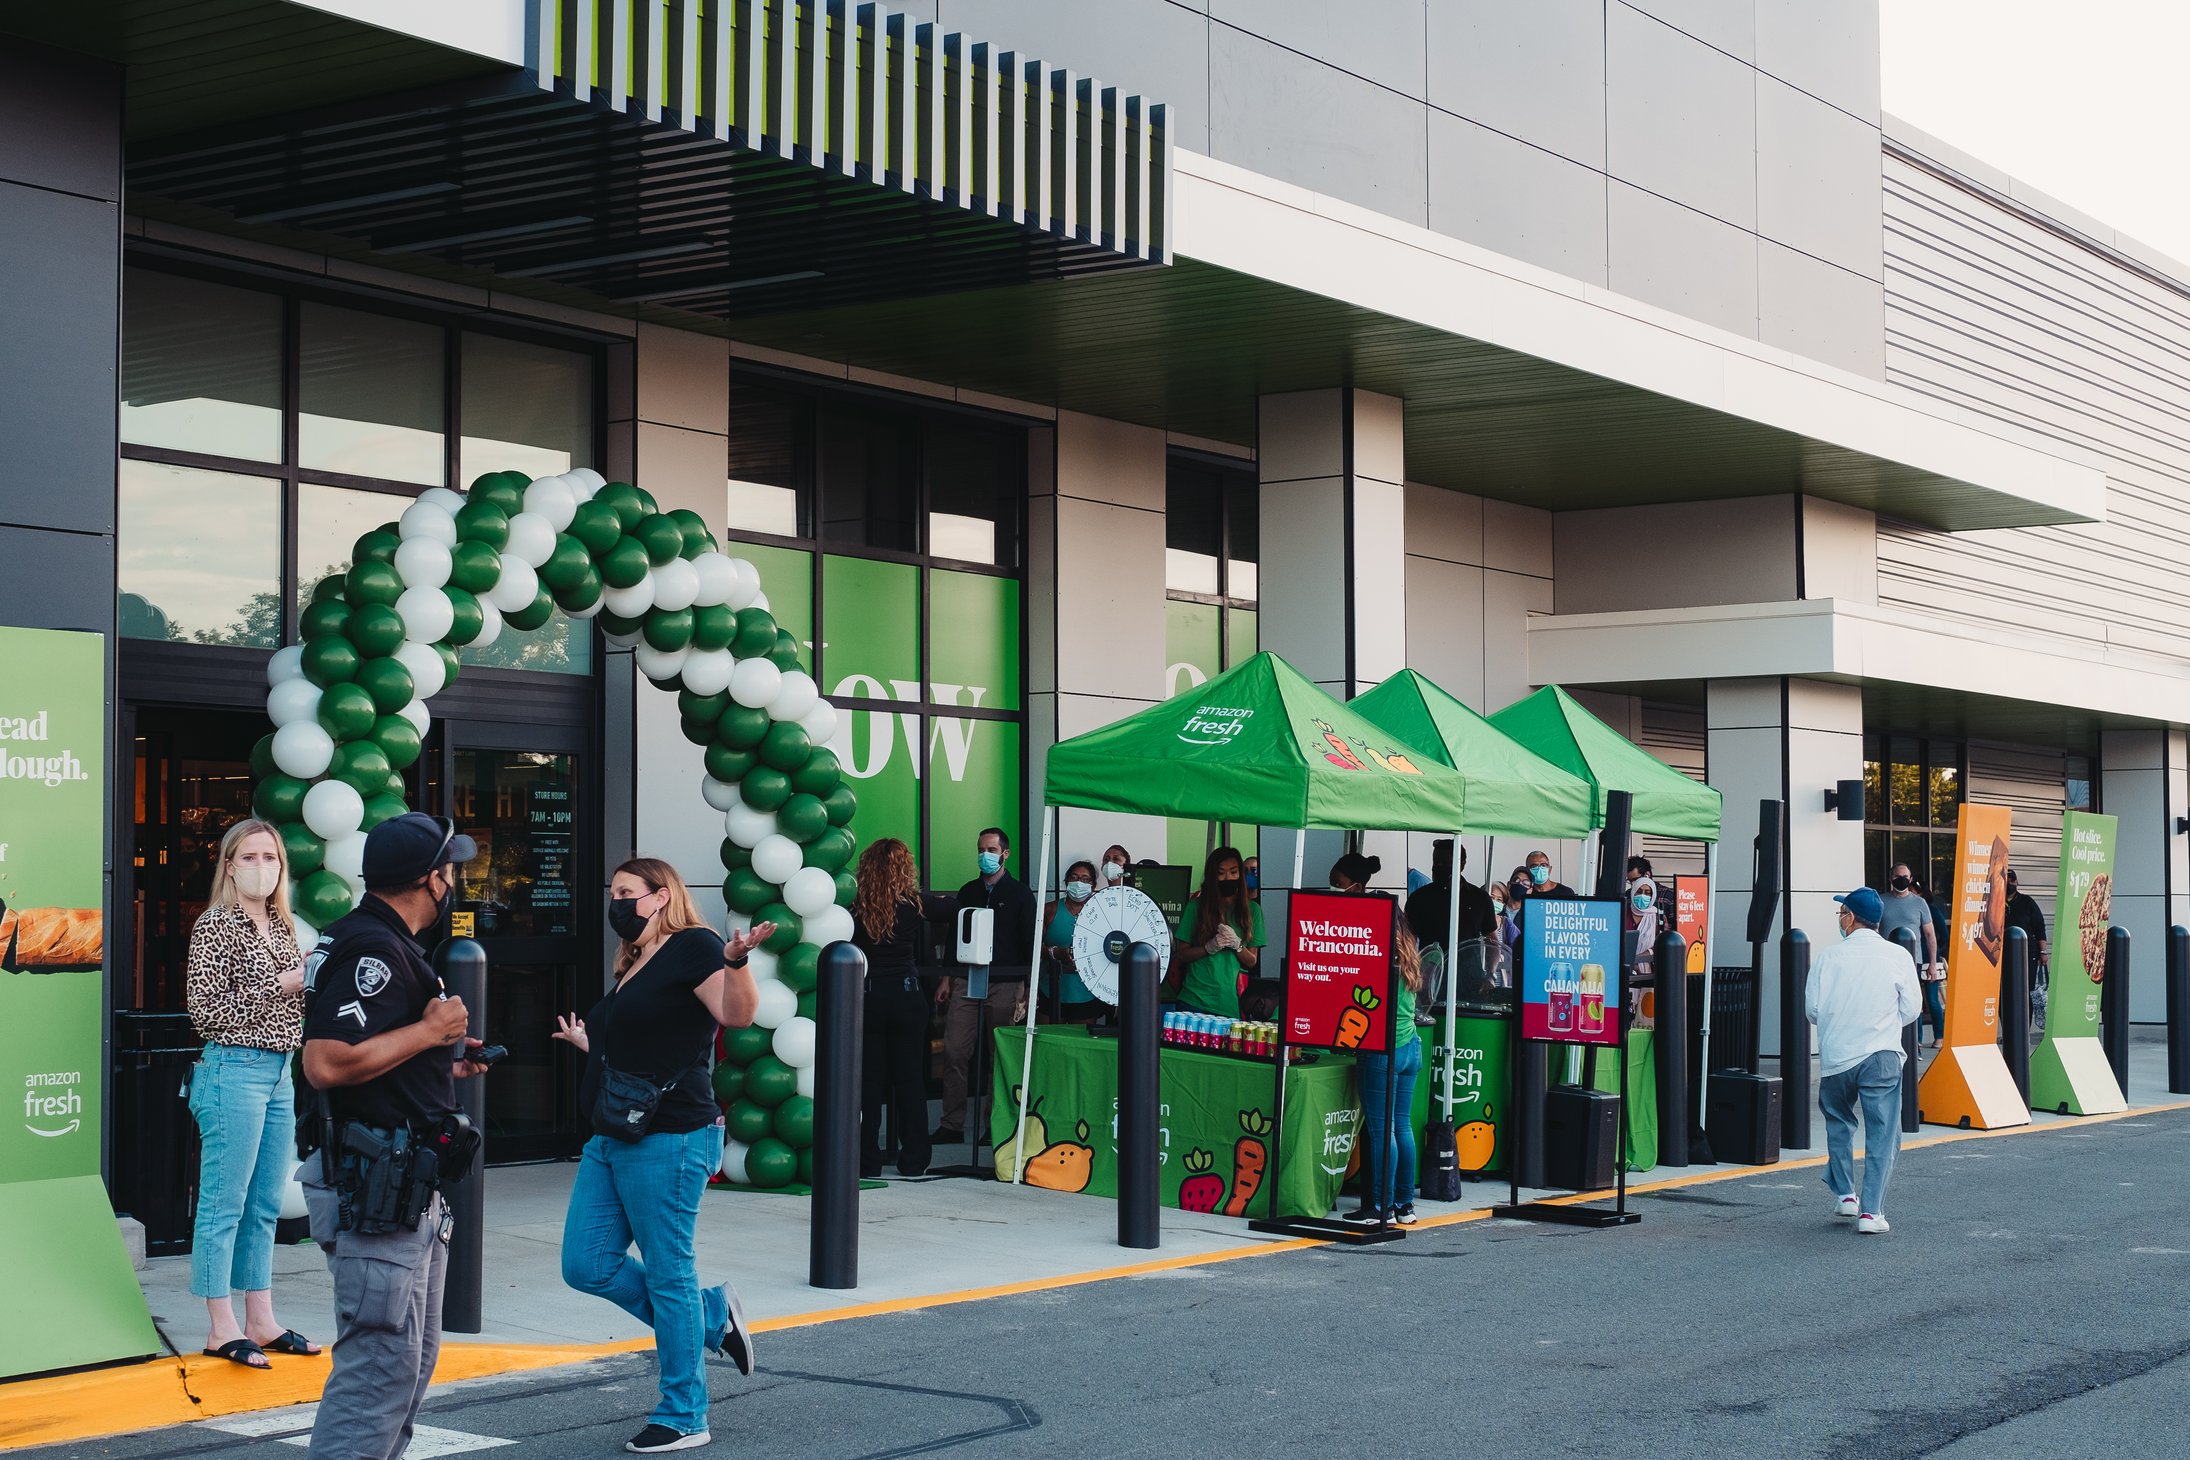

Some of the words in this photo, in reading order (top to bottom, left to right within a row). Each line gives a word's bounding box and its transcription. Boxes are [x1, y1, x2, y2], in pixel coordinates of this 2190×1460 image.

[1196, 706, 1255, 719] amazon
[1183, 716, 1243, 735] fresh
[535, 791, 550, 799] STORE
[551, 792, 567, 800] HOURS
[531, 811, 546, 823] 7AM
[553, 812, 571, 823] 10PM
[2073, 828, 2086, 843] Hot
[2086, 829, 2102, 844] slice.
[2072, 845, 2087, 860] Cool
[2087, 847, 2105, 864] price.
[1967, 859, 1990, 874] winner
[1965, 877, 1991, 893] chicken
[1679, 889, 1695, 900] Please
[1162, 900, 1176, 911] win
[1545, 901, 1586, 916] DOUBLY
[1679, 902, 1689, 913] stay
[1690, 900, 1694, 911] 6
[1694, 900, 1704, 911] feet
[1964, 896, 1987, 912] dinner.
[1545, 916, 1609, 932] DELIGHTFUL
[1679, 913, 1694, 924] apart.
[1299, 920, 1373, 939] Welcome
[1545, 931, 1590, 946] FLAVORS
[1298, 937, 1383, 957] Franconia.
[1545, 945, 1556, 959] IN
[1559, 946, 1591, 960] EVERY
[364, 959, 389, 977] SILBAR
[1297, 962, 1316, 971] Visit
[1339, 966, 1360, 975] your
[1297, 973, 1314, 982] way
[1315, 974, 1331, 982] out.
[1295, 1021, 1311, 1029] fresh
[25, 1071, 81, 1087] amazon
[24, 1088, 81, 1117] fresh
